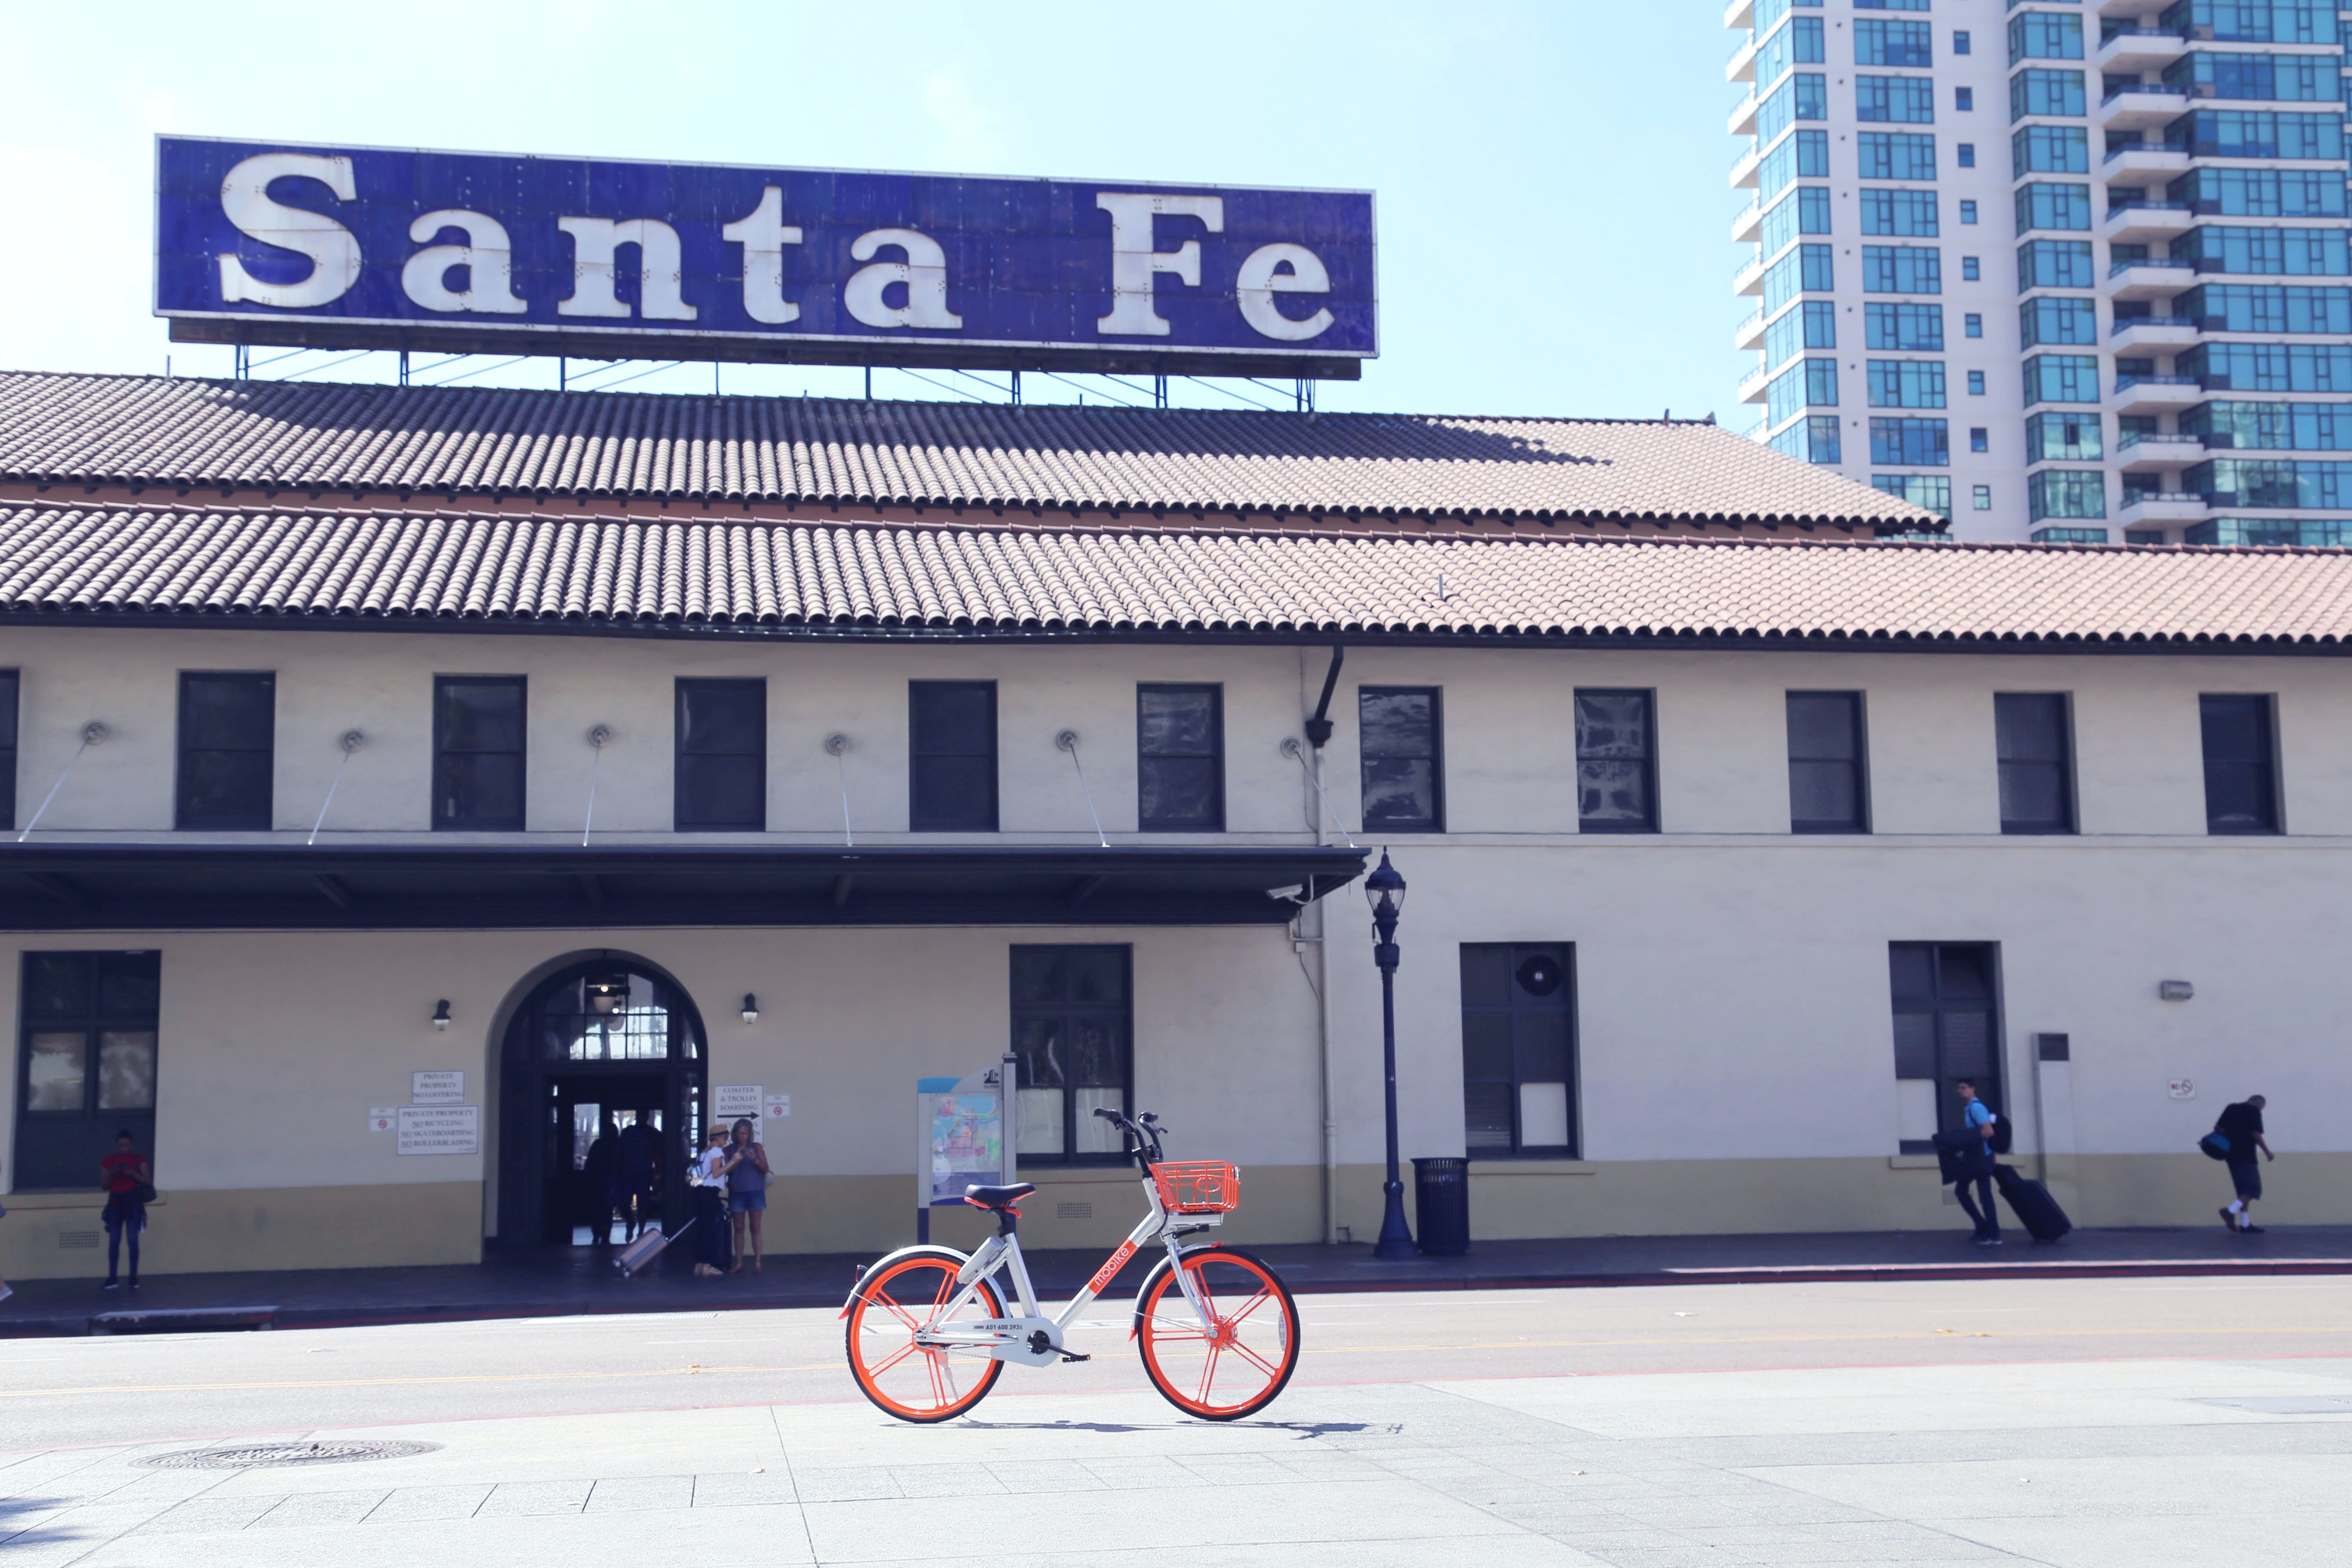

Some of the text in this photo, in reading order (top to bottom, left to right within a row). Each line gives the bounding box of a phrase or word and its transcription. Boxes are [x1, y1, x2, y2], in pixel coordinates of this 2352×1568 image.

[220, 152, 1335, 340] Santa Fe
[1094, 1248, 1129, 1286] mobike
